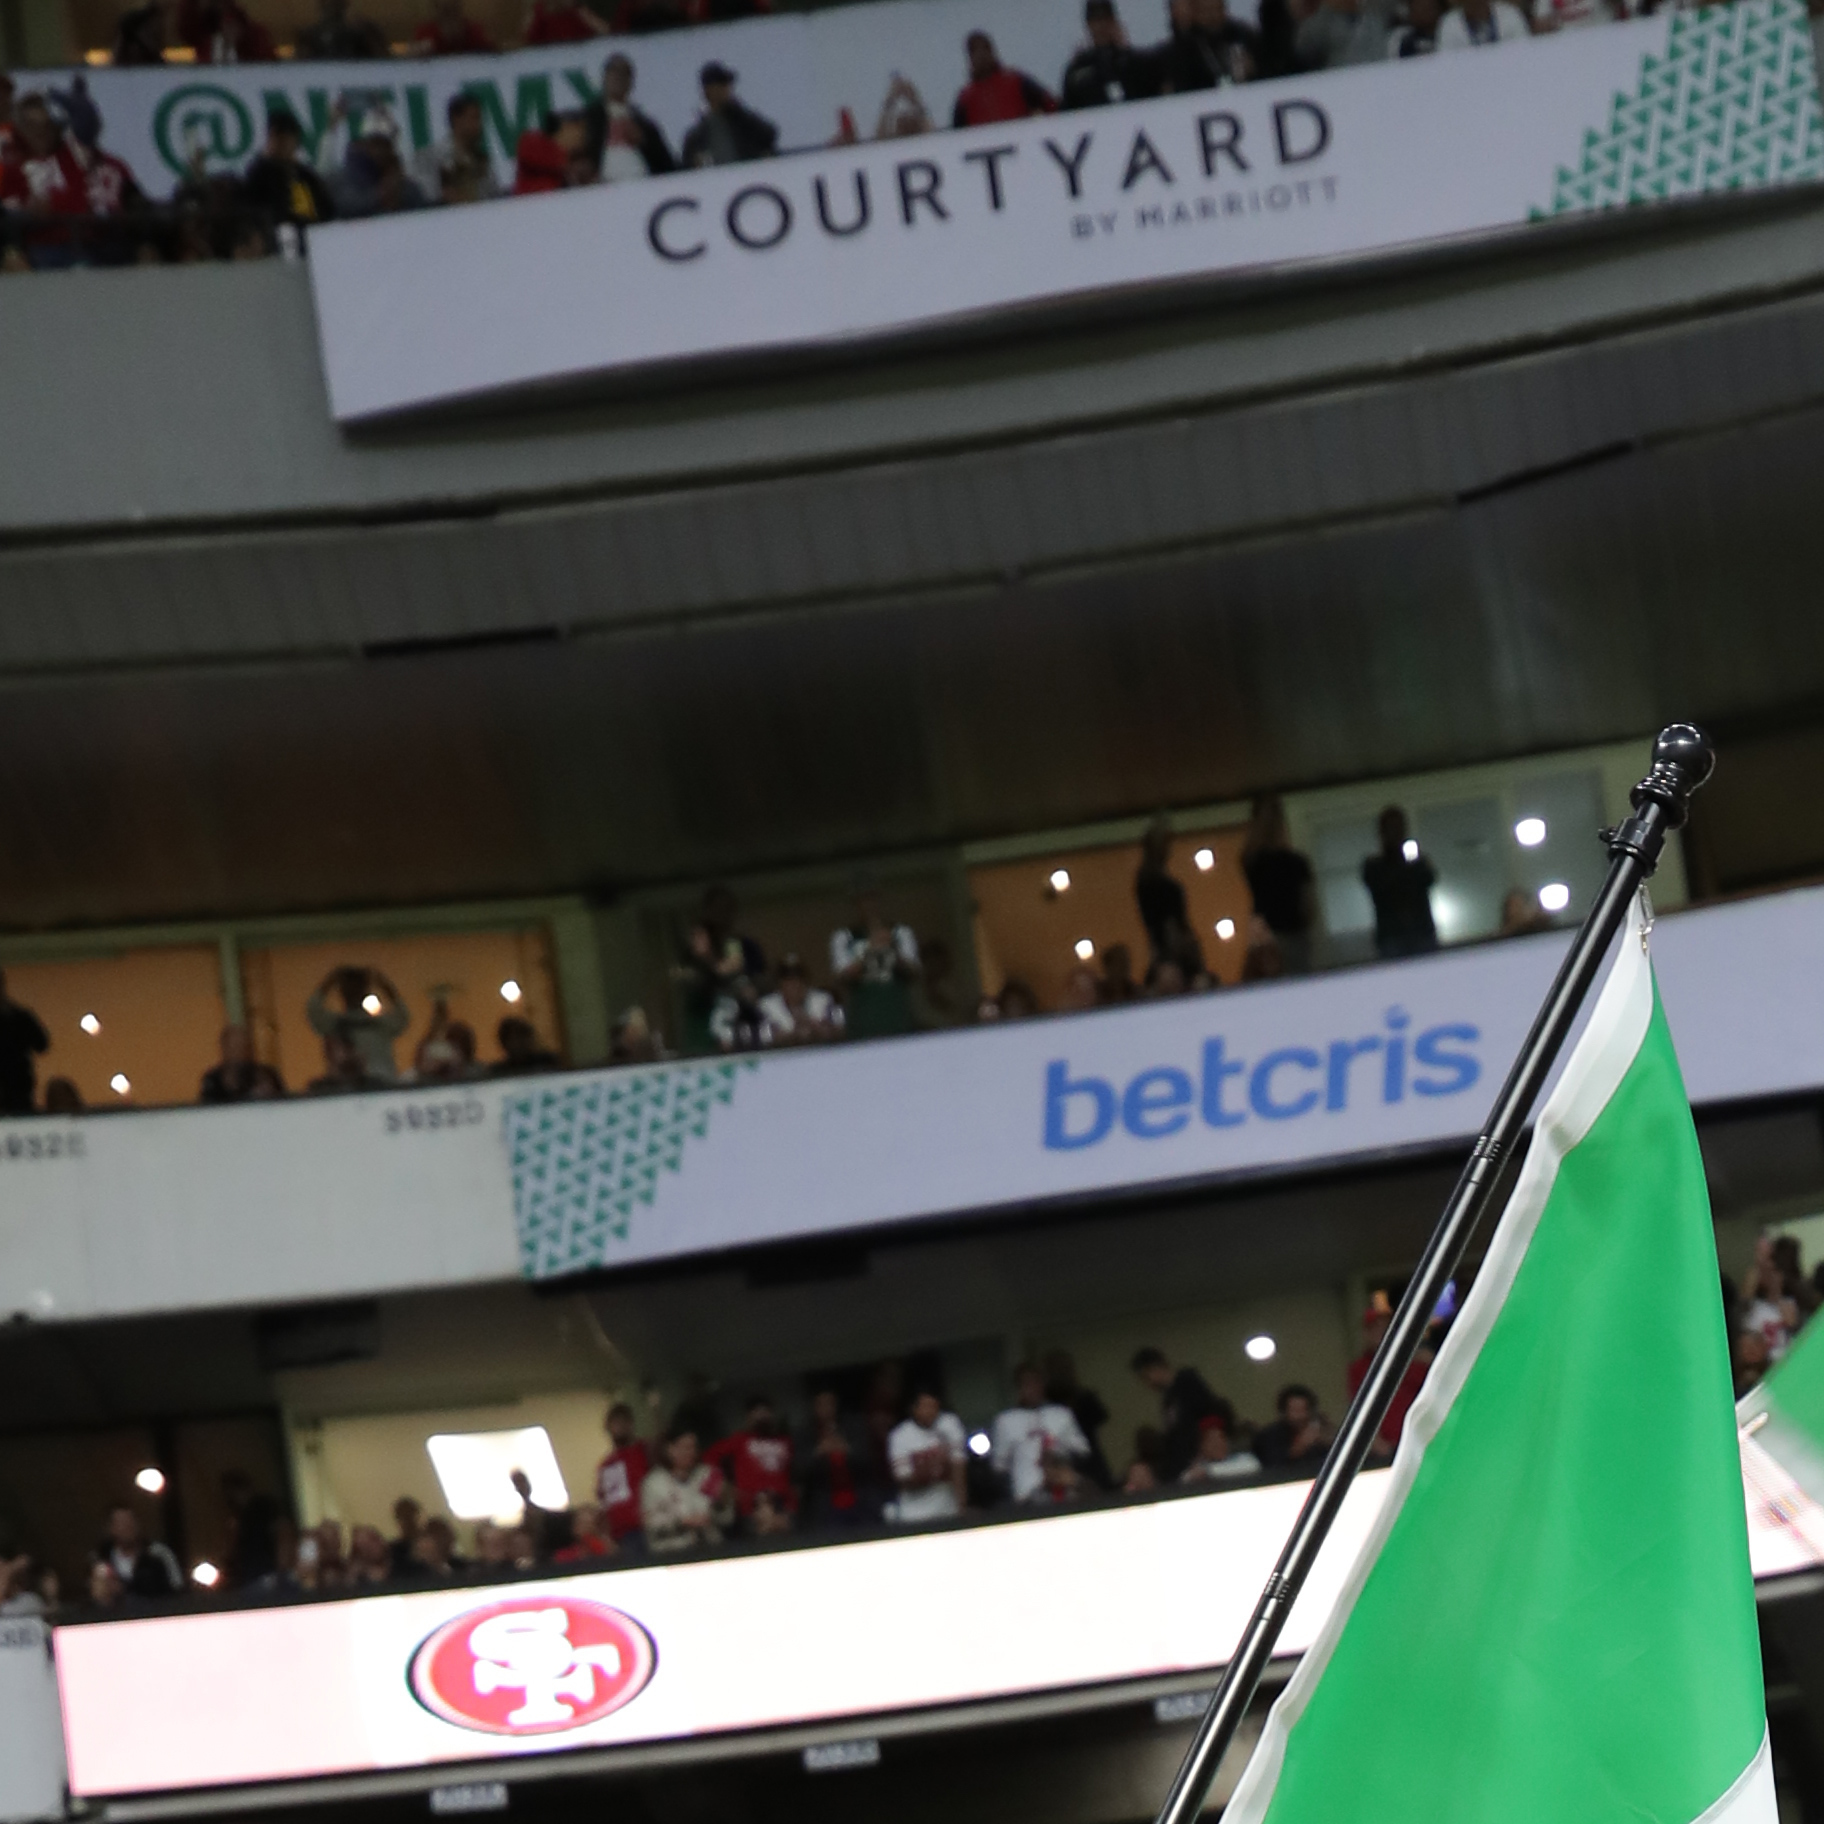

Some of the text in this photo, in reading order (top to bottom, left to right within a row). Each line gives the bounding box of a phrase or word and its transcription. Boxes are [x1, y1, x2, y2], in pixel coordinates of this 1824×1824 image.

[647, 98, 1332, 261] COURTYARD
[1071, 178, 1339, 240] BY MARRIOTT
[1042, 1006, 1482, 1153] betcris
